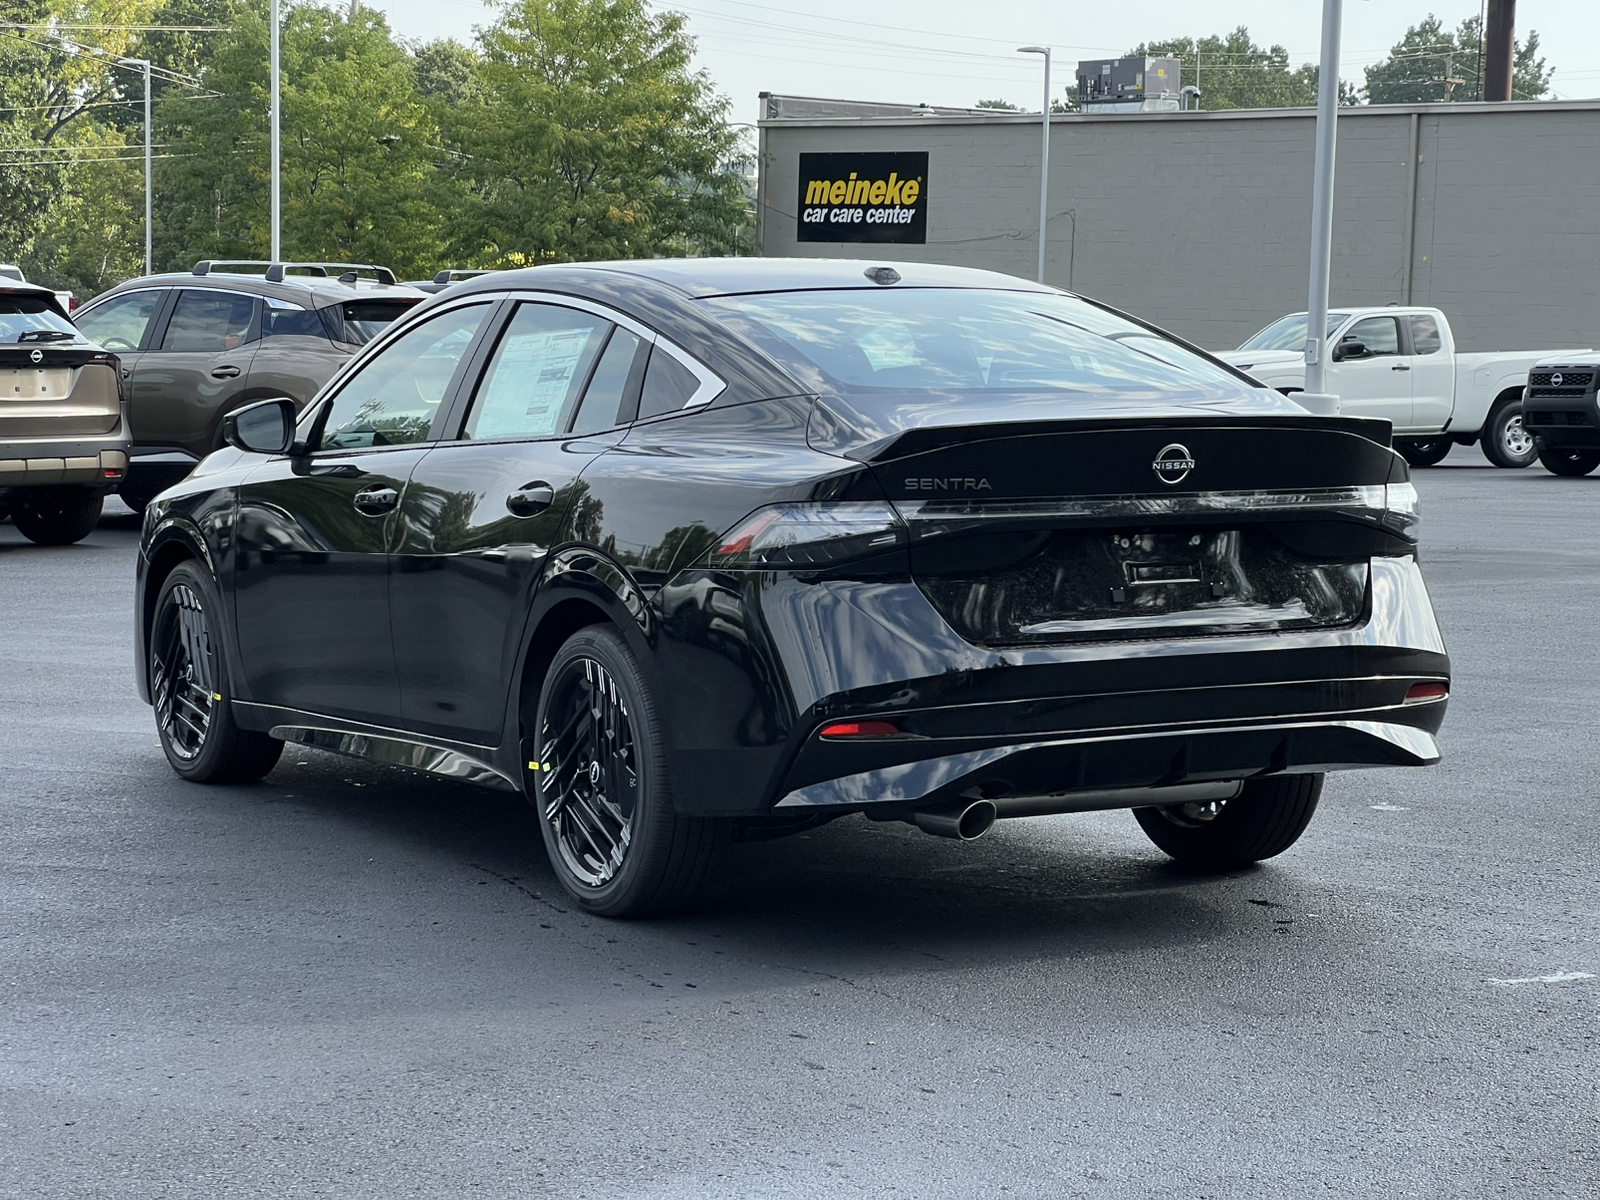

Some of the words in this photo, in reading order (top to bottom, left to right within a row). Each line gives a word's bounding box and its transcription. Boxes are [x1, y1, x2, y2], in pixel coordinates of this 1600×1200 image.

[805, 172, 920, 205] meineke
[803, 208, 828, 223] car
[830, 208, 863, 223] care
[866, 205, 916, 224] center
[1152, 461, 1194, 470] NISSAN
[904, 478, 992, 490] SENTRA
